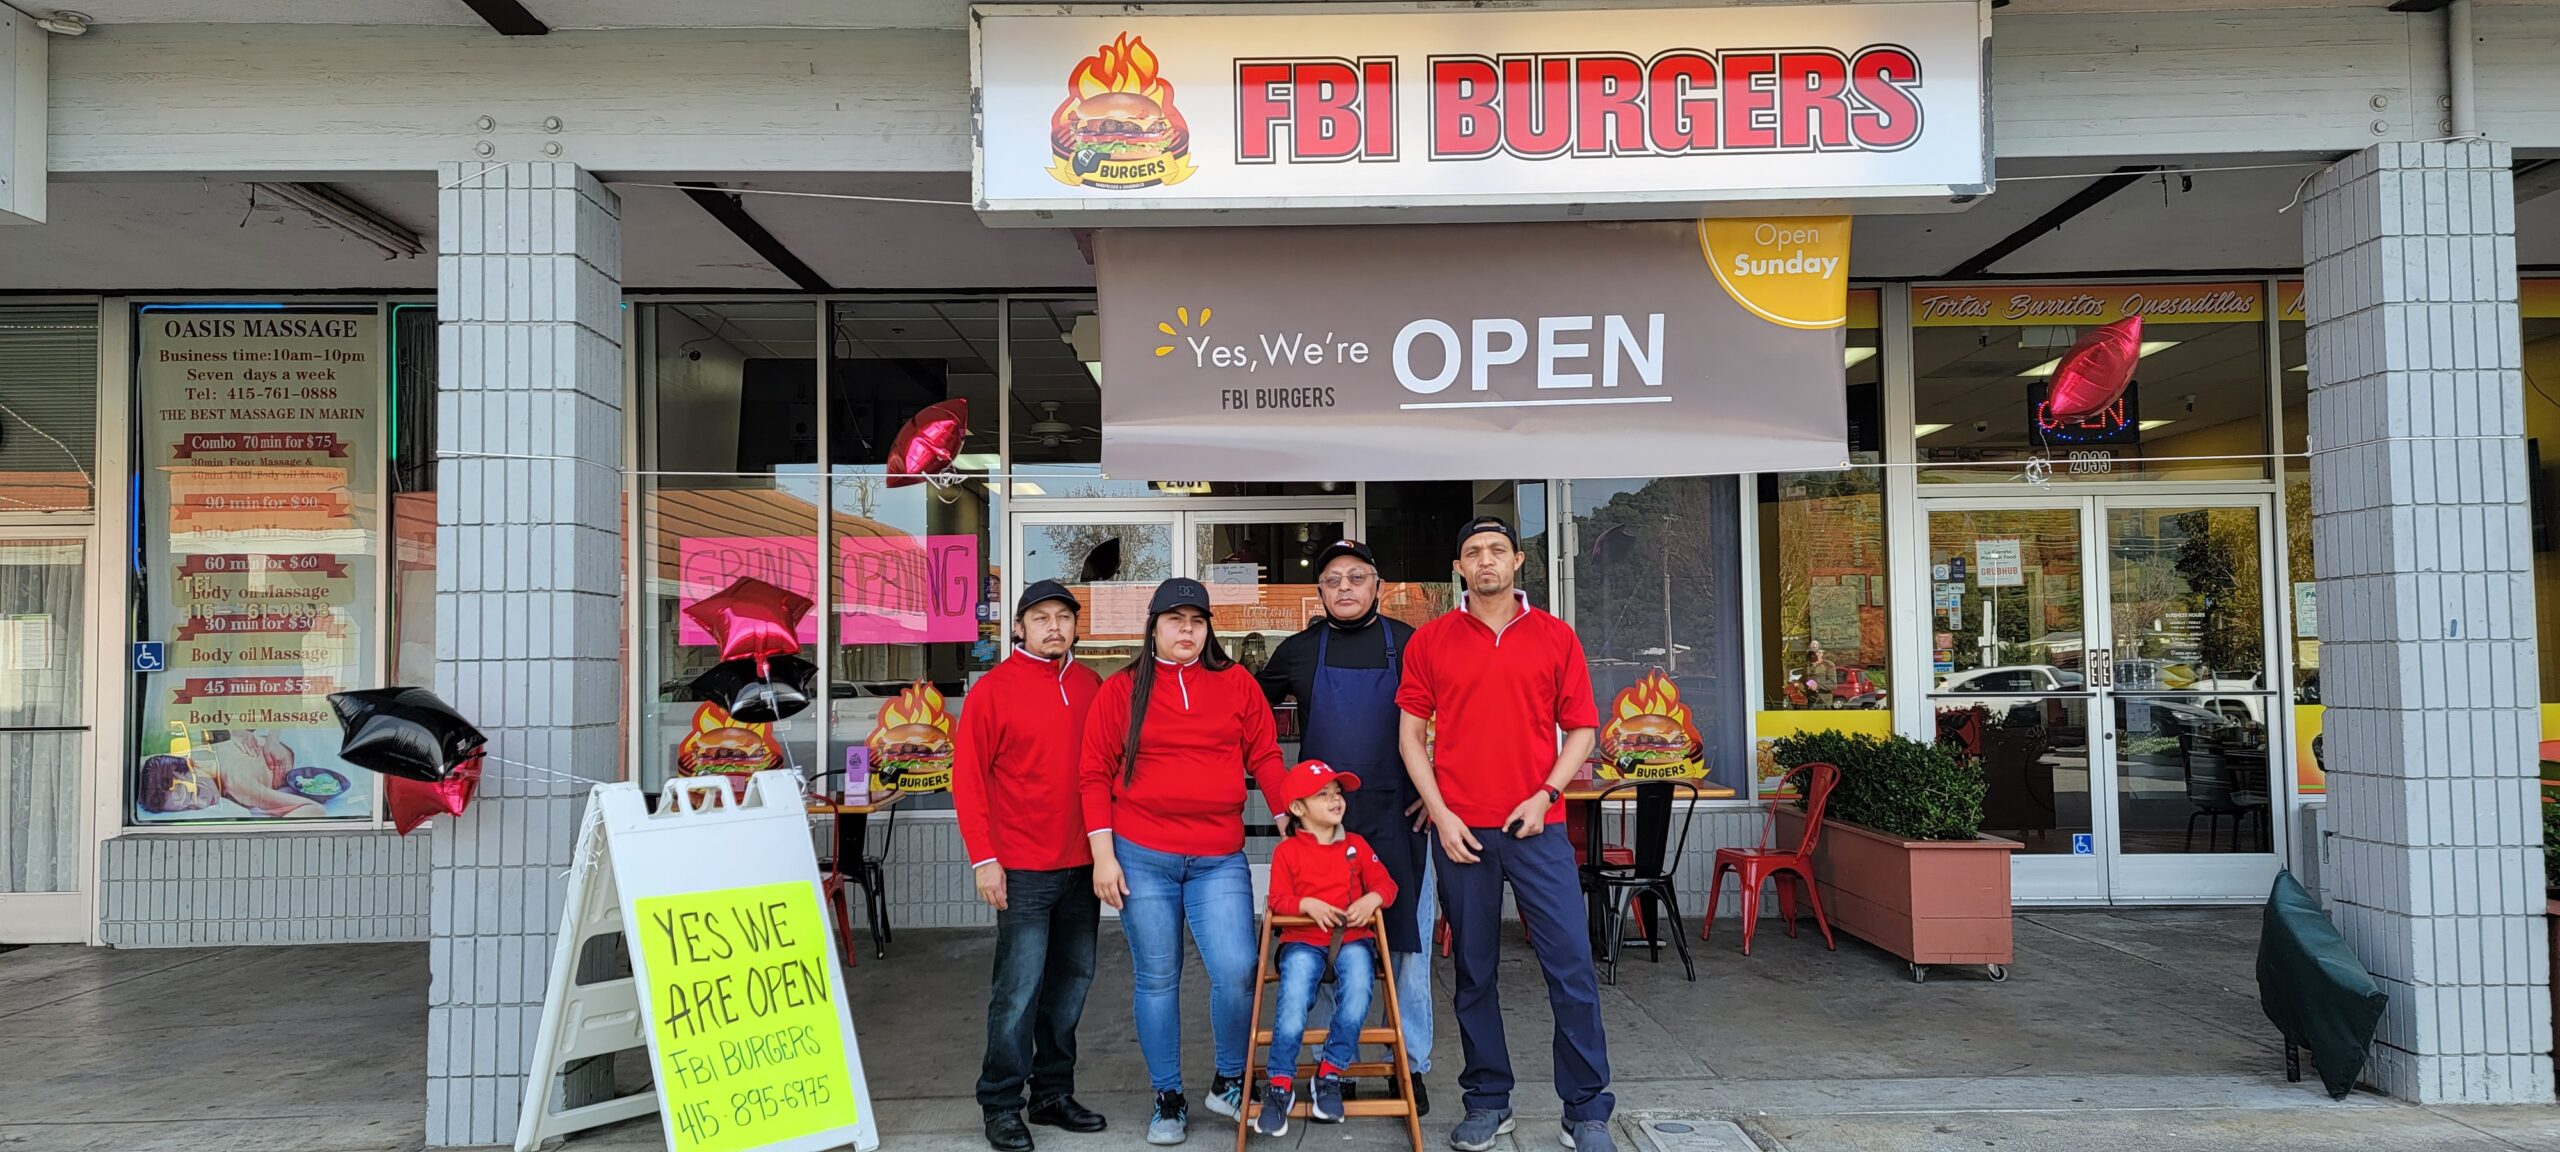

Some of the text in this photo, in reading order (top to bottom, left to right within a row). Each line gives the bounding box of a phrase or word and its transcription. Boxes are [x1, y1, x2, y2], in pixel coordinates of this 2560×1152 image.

[1233, 43, 1924, 164] FBI BURGERS
[1100, 160, 1165, 178] BURGERS
[1755, 223, 1819, 251] Open
[1734, 250, 1839, 279] Sunday
[1922, 290, 2254, 321] Tortas Burritos Quesadillas
[164, 319, 358, 338] OASIS MASSAGE
[159, 350, 228, 363] Business
[1392, 313, 1664, 394] OPEN
[187, 368, 336, 383] Seven days a week
[185, 387, 338, 401] Tel: 415-761-0888
[1222, 387, 1335, 410] FBI BURGERS
[160, 408, 365, 421] THE BEST MASSAGE IN MARIN
[191, 436, 236, 450] Combo
[284, 436, 304, 449] for
[191, 457, 313, 469] 30min Foot Massage &
[2069, 450, 2111, 474] 2033
[205, 496, 225, 510] 90
[229, 496, 261, 510] min
[262, 496, 286, 510] for
[205, 557, 226, 570] 60
[229, 557, 261, 570] min
[264, 556, 286, 569] for
[840, 545, 968, 617] OPENING
[263, 586, 329, 601] Massage
[205, 618, 226, 631] 30
[230, 617, 261, 630] min
[262, 616, 284, 630] for
[192, 648, 329, 664] Body oil Massage
[2090, 652, 2098, 685] PULL
[2102, 652, 2110, 685] PULL
[204, 679, 312, 694] 45 min for $55
[189, 709, 329, 725] Body oil Massage
[1636, 765, 1685, 778] BURGERS
[900, 774, 950, 787] BURGERS
[653, 902, 795, 966] YES WE
[664, 957, 828, 1039] ARE OPEN
[669, 1025, 821, 1089] FBI BURGERS
